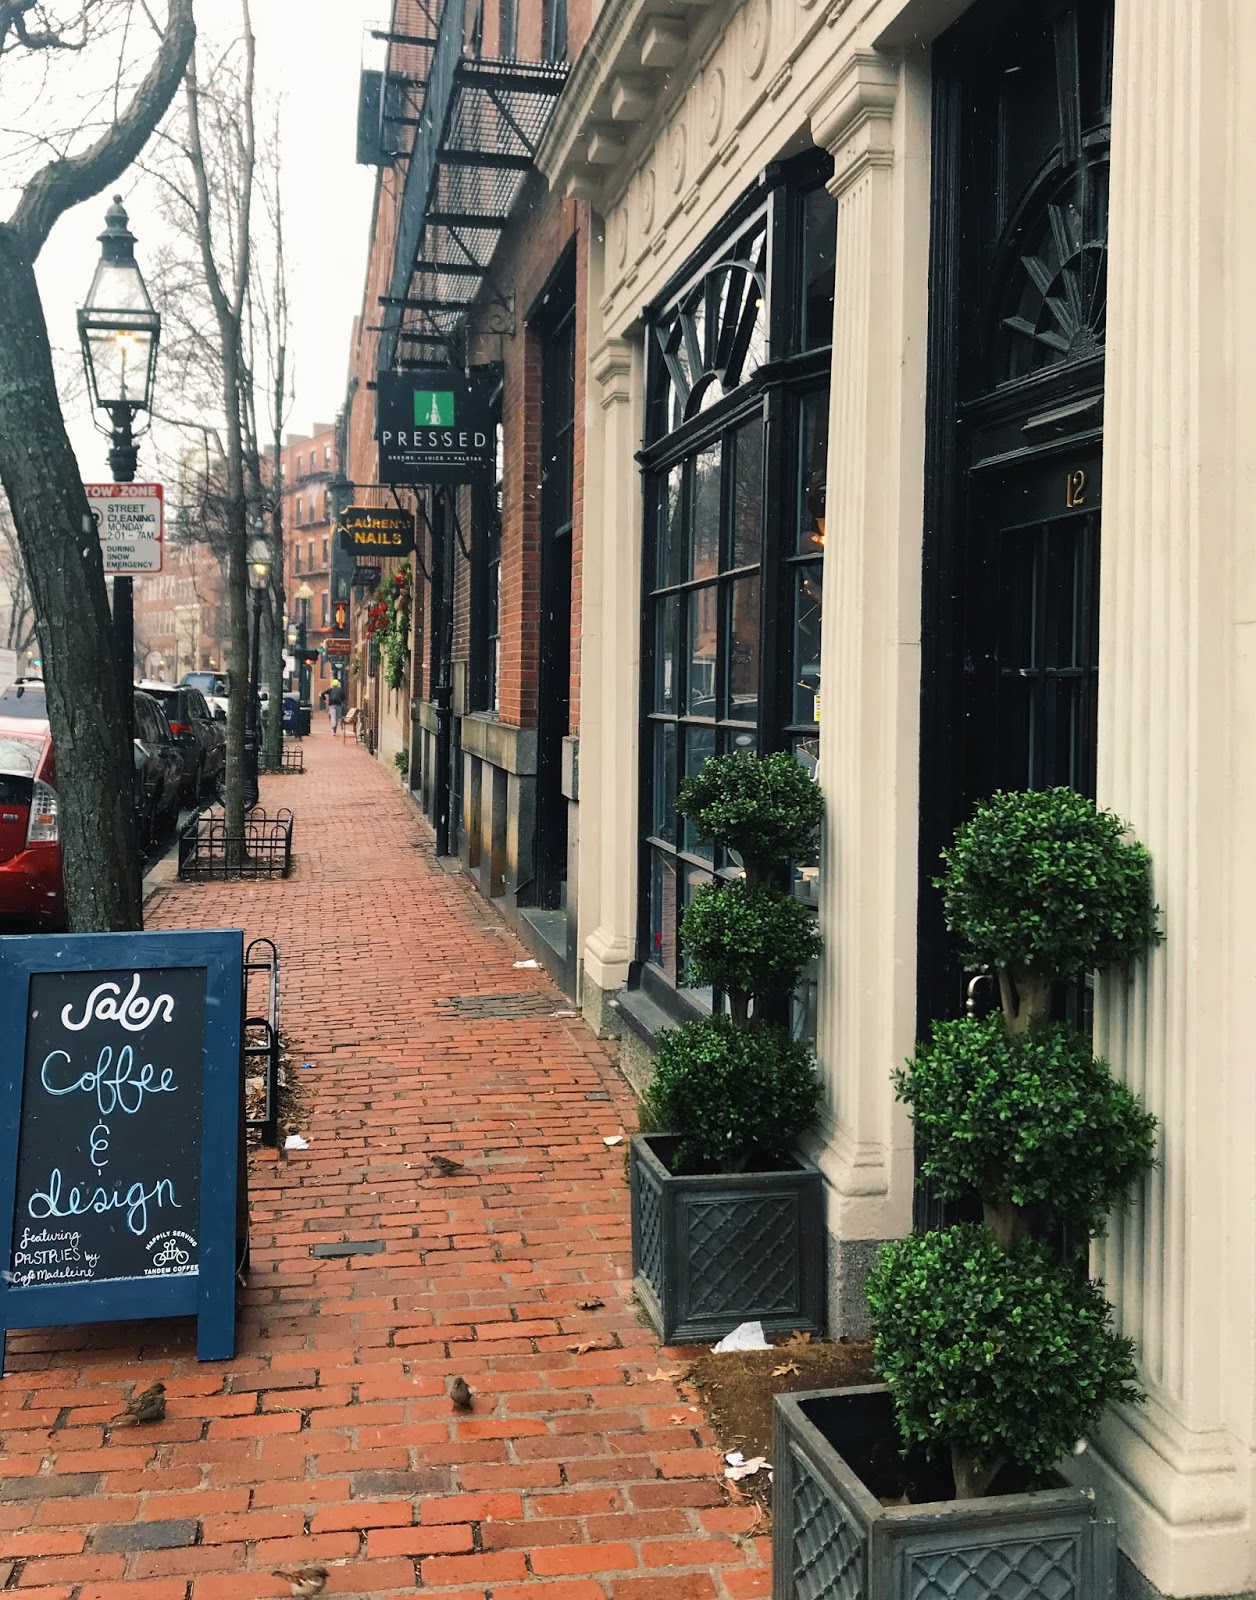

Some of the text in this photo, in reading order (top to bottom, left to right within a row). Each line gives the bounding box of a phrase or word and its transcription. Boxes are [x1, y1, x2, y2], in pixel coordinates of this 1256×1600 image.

[382, 431, 486, 447] PRESSED
[84, 486, 157, 497] TOW ZONE
[1066, 470, 1085, 508] 12
[107, 504, 146, 513] STREET
[107, 514, 156, 523] CLEANING
[107, 523, 145, 531] MONDAY
[137, 531, 154, 540] 7AM
[354, 532, 402, 545] NAILS
[61, 972, 175, 1031] Salon
[41, 1045, 178, 1115] Coffee
[28, 1168, 182, 1236] design
[20, 1227, 81, 1249] featuring
[145, 1230, 198, 1251] HAPPILY SERVING
[14, 1247, 101, 1268] PASTRIES by
[37, 1266, 95, 1280] Madeleine
[144, 1264, 199, 1275] TANDEM COFFEE
